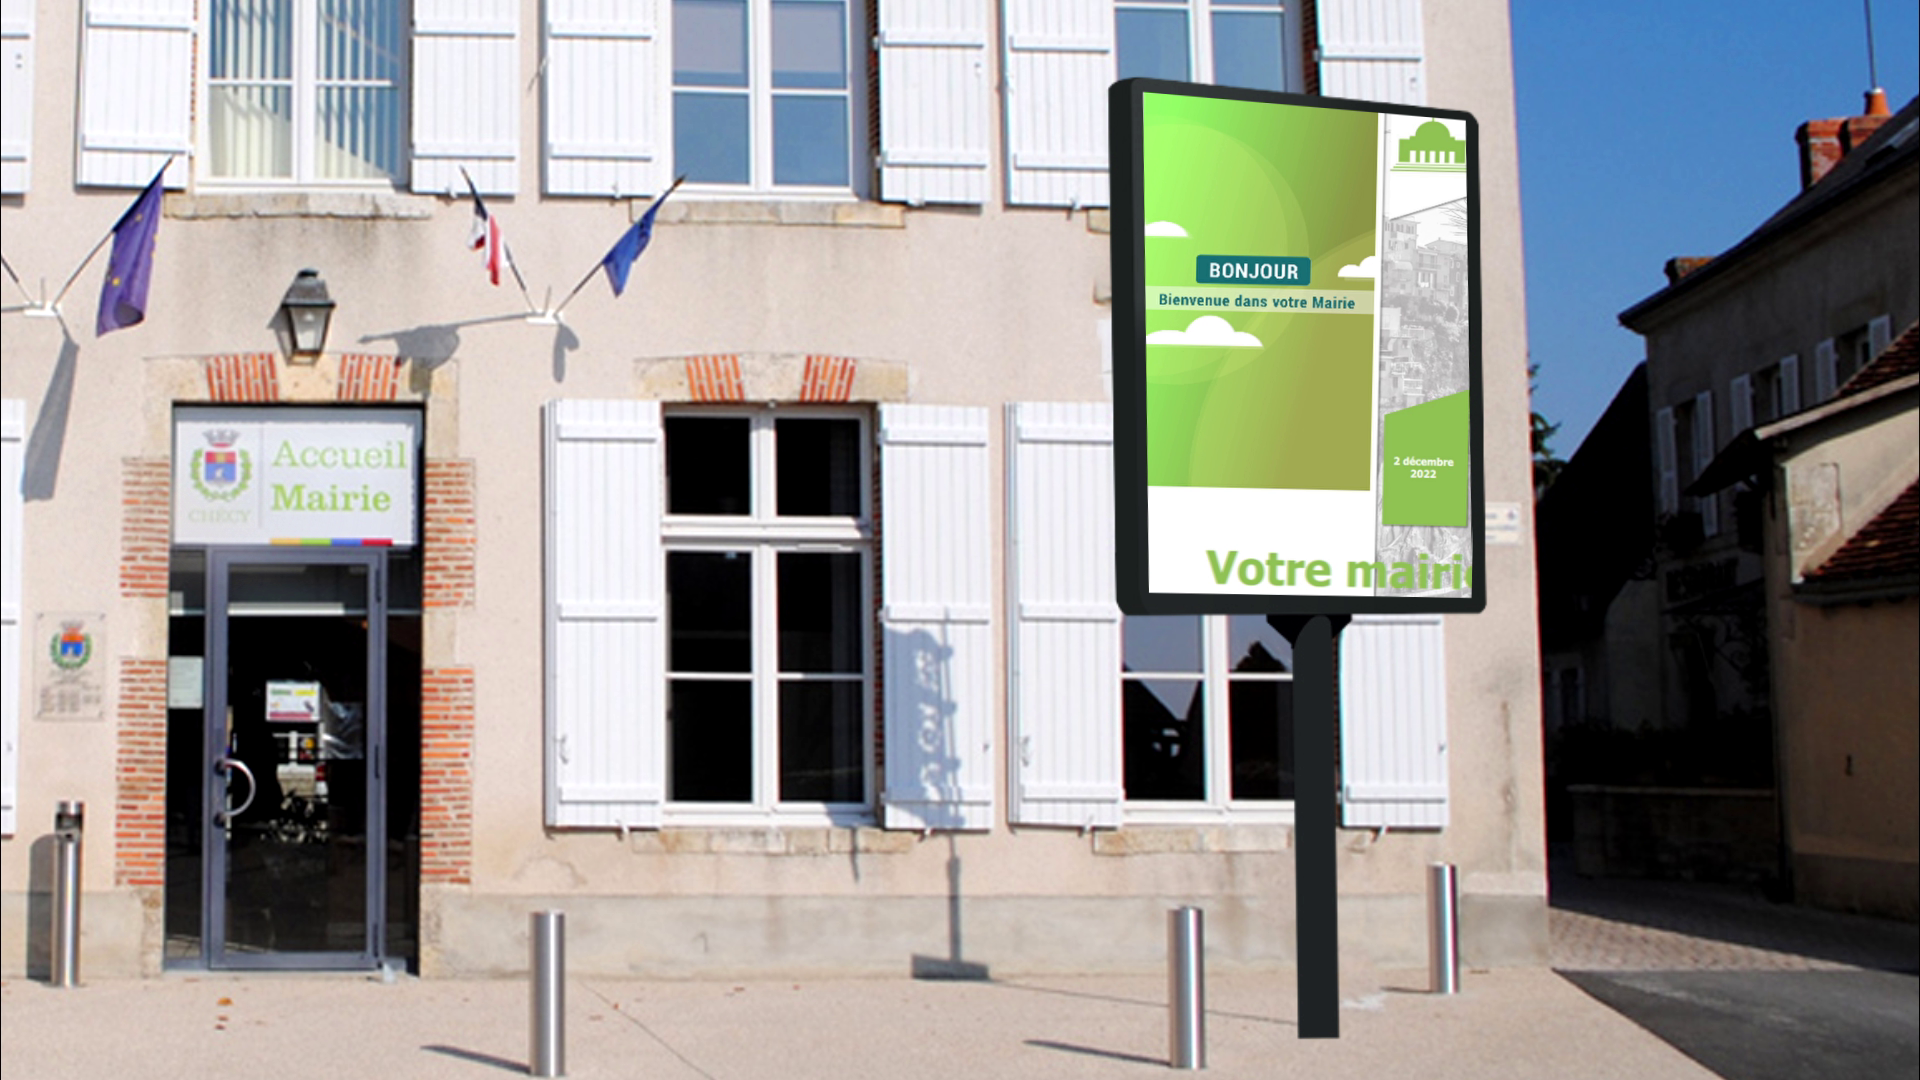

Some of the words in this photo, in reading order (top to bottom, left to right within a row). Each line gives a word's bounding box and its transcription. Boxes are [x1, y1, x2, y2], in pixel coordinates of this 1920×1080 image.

[1209, 262, 1299, 280] BONJOUR
[1159, 293, 1230, 307] Bienvenue
[1234, 294, 1268, 307] dans
[1273, 296, 1307, 308] votre
[1312, 296, 1356, 310] Mairie
[271, 439, 407, 469] Accueil
[1393, 456, 1401, 466] 2
[1402, 456, 1455, 467] décembre
[1410, 469, 1437, 479] 2022
[271, 483, 392, 512] Mairie
[1206, 550, 1332, 587] Votre
